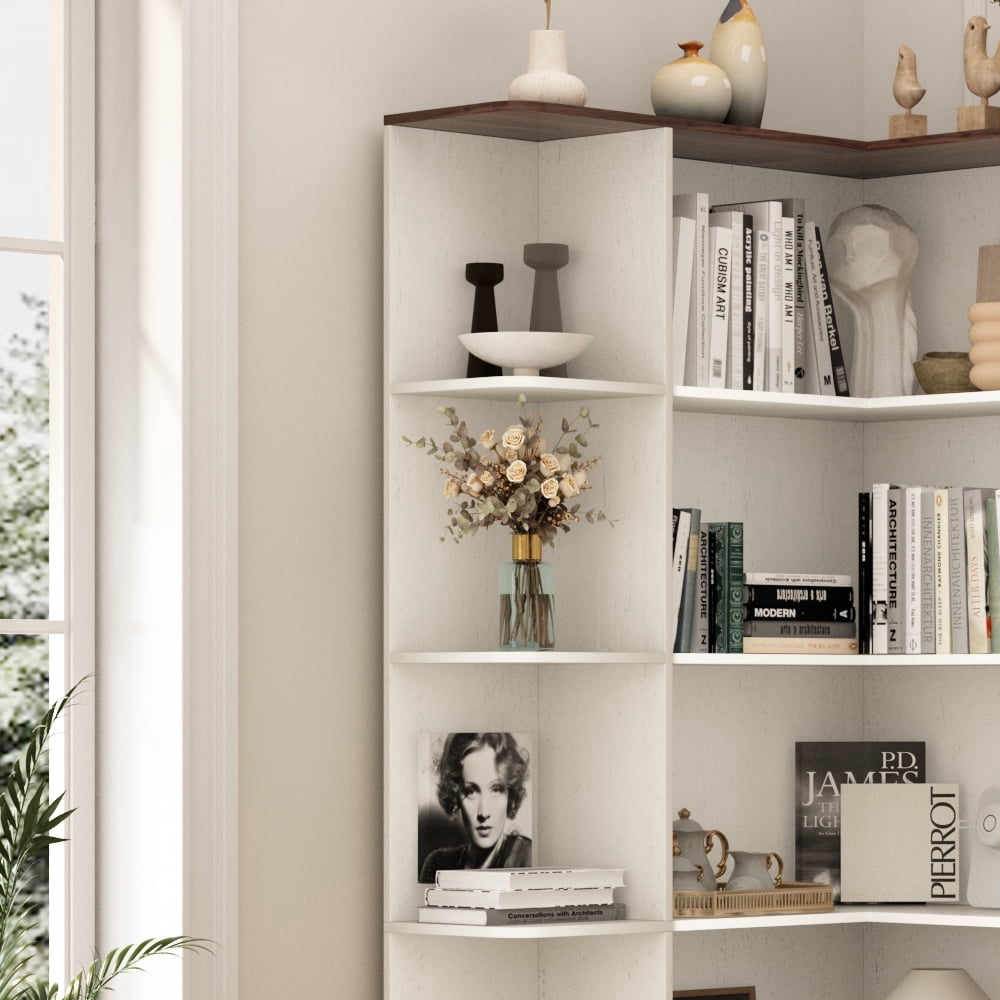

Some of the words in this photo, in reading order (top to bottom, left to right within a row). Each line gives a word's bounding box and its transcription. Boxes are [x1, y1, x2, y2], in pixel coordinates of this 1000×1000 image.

[797, 213, 803, 224] To
[785, 230, 793, 250] WHO
[717, 247, 729, 293] CUBISM
[785, 253, 793, 265] AM
[796, 250, 804, 302] Mockingbird
[785, 282, 793, 302] WHO
[715, 296, 726, 320] ART
[785, 304, 793, 317] AM
[825, 305, 840, 351] Berkel
[888, 499, 897, 609] ARCHITECTURE
[949, 497, 960, 630] INNENARCHITEKTUR
[700, 531, 708, 619] ARCHITECTURE
[922, 516, 933, 644] INNENARCHITEKTUR
[754, 607, 796, 618] MODERN
[881, 751, 919, 769] P.D.
[930, 786, 956, 898] PIERROT
[507, 911, 554, 920] Conversations
[571, 909, 603, 917] Architects
